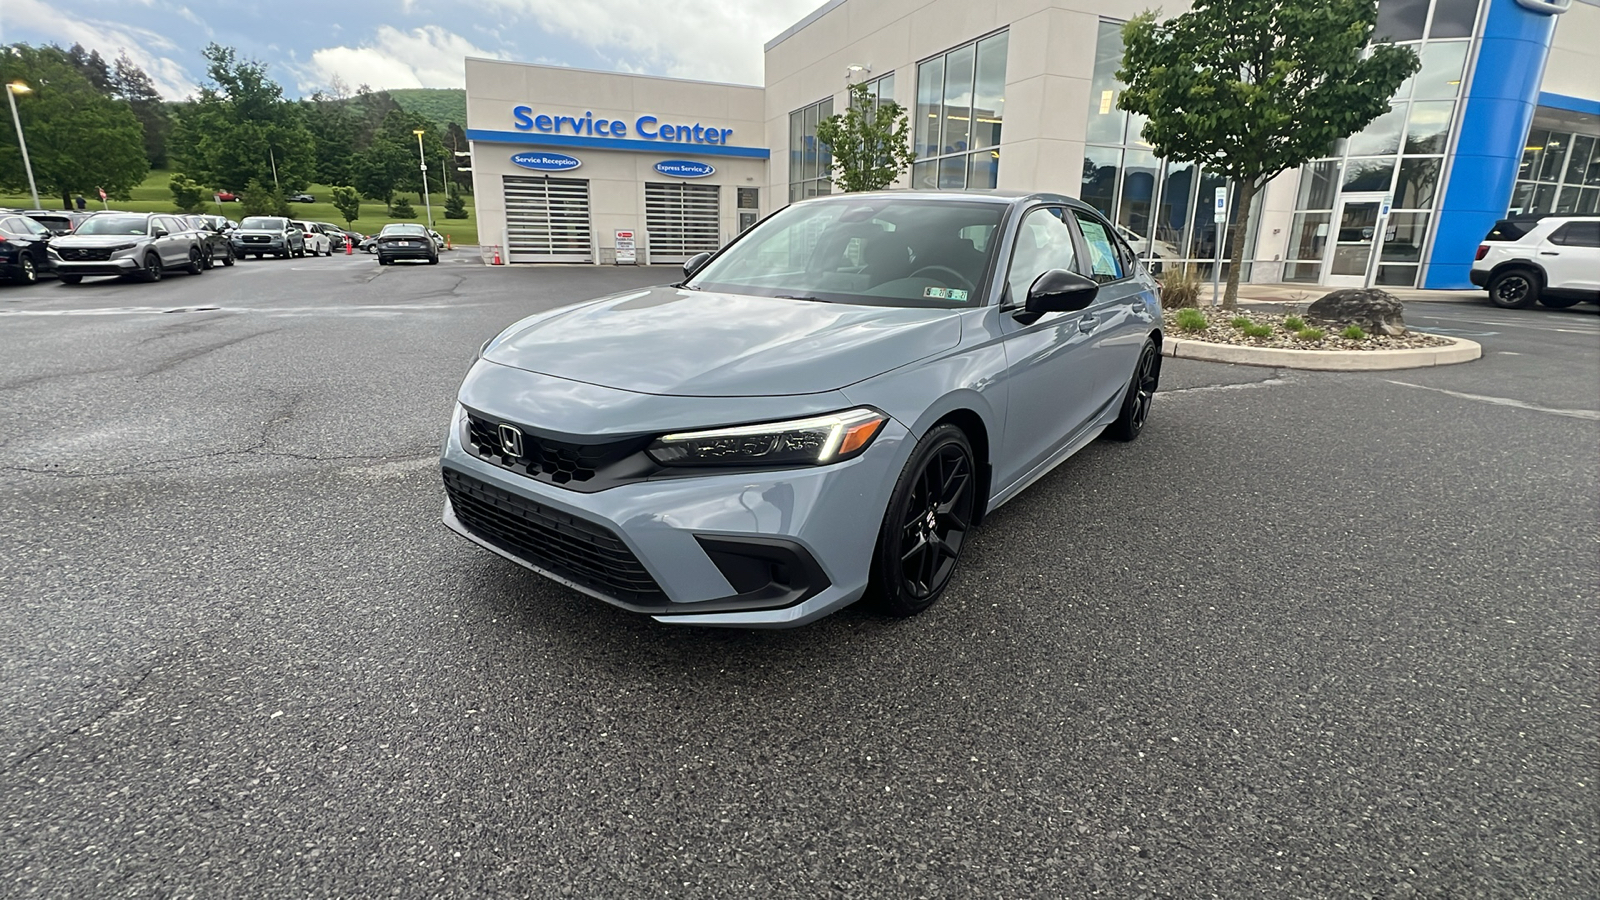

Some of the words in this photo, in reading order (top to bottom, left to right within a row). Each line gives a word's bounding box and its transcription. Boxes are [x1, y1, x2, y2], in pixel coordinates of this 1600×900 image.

[513, 105, 627, 138] Service
[635, 115, 733, 145] Center
[514, 155, 541, 164] Service
[542, 157, 577, 166] Reception
[657, 163, 680, 172] Express
[681, 165, 703, 173] Service
